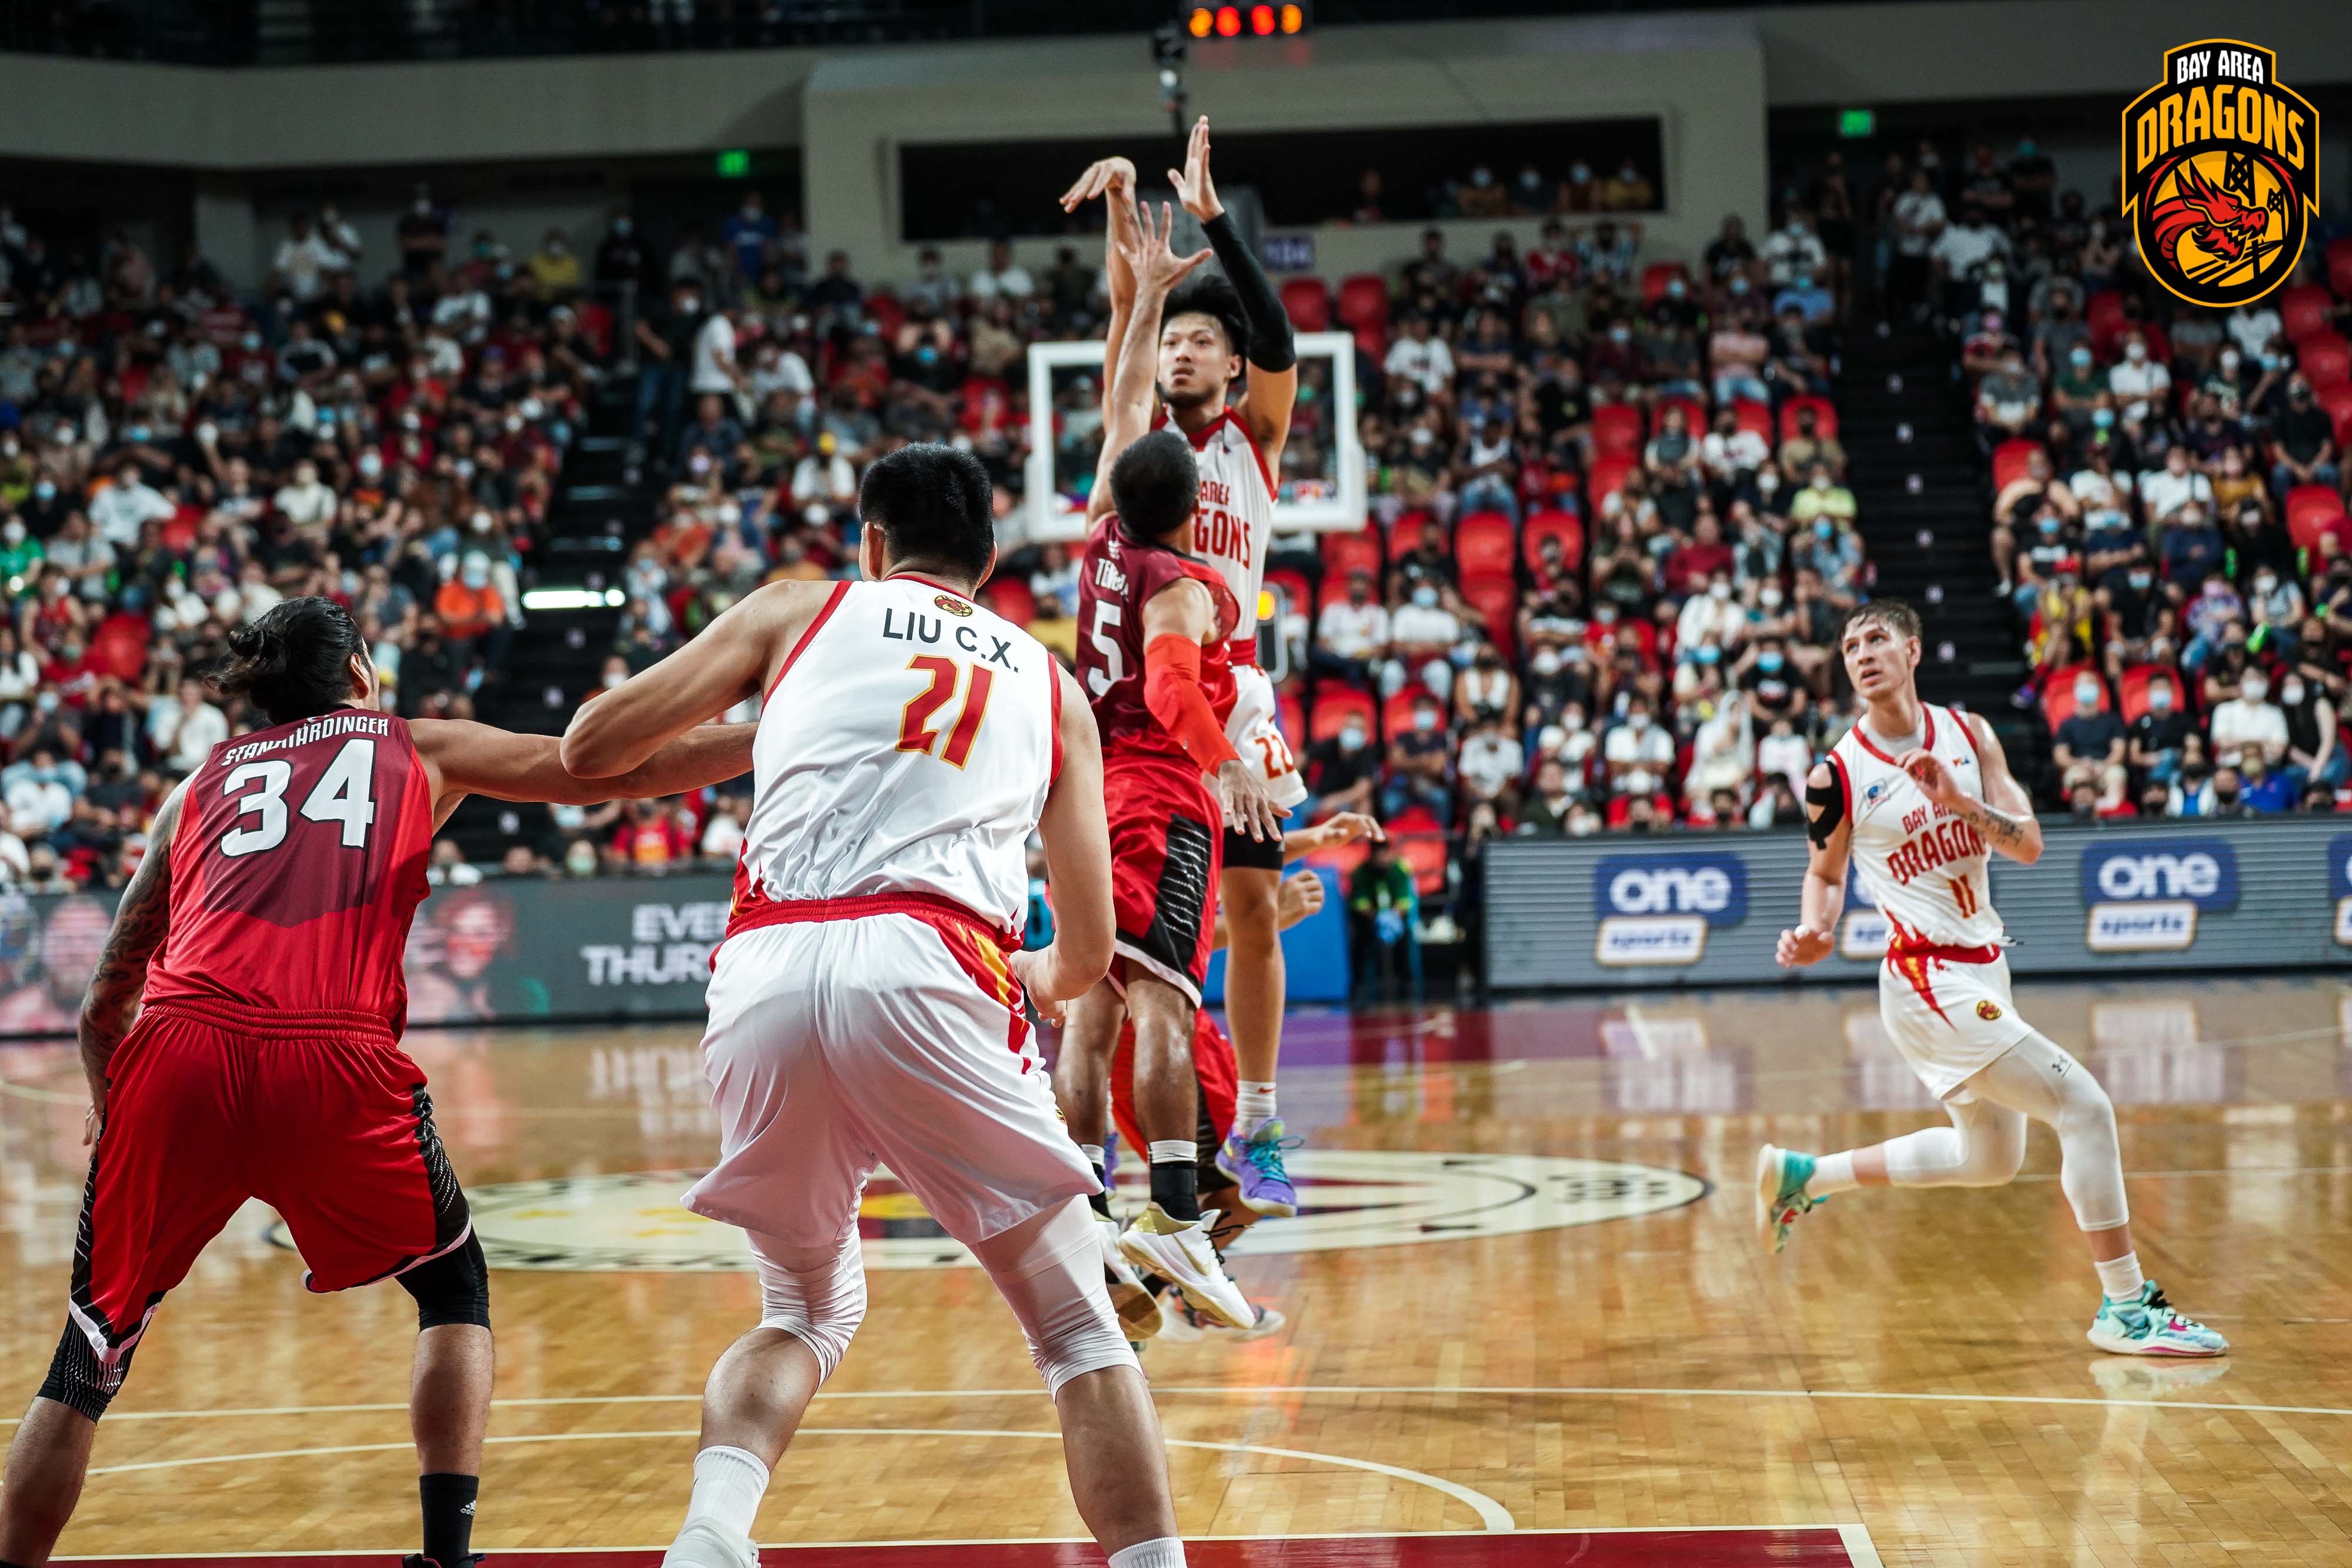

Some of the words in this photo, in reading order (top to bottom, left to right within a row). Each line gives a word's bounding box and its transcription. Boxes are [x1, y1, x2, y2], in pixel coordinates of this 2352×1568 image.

[883, 608, 941, 644] LIU
[955, 626, 1018, 673] C.X.
[1087, 599, 1124, 697] 5
[894, 653, 995, 771] 21
[219, 737, 377, 859] 34
[1902, 805, 1927, 835] BAY
[1886, 818, 1987, 887] DRAGON
[2097, 851, 2221, 900] one
[1608, 866, 1732, 914] one
[1948, 874, 1977, 919] 11
